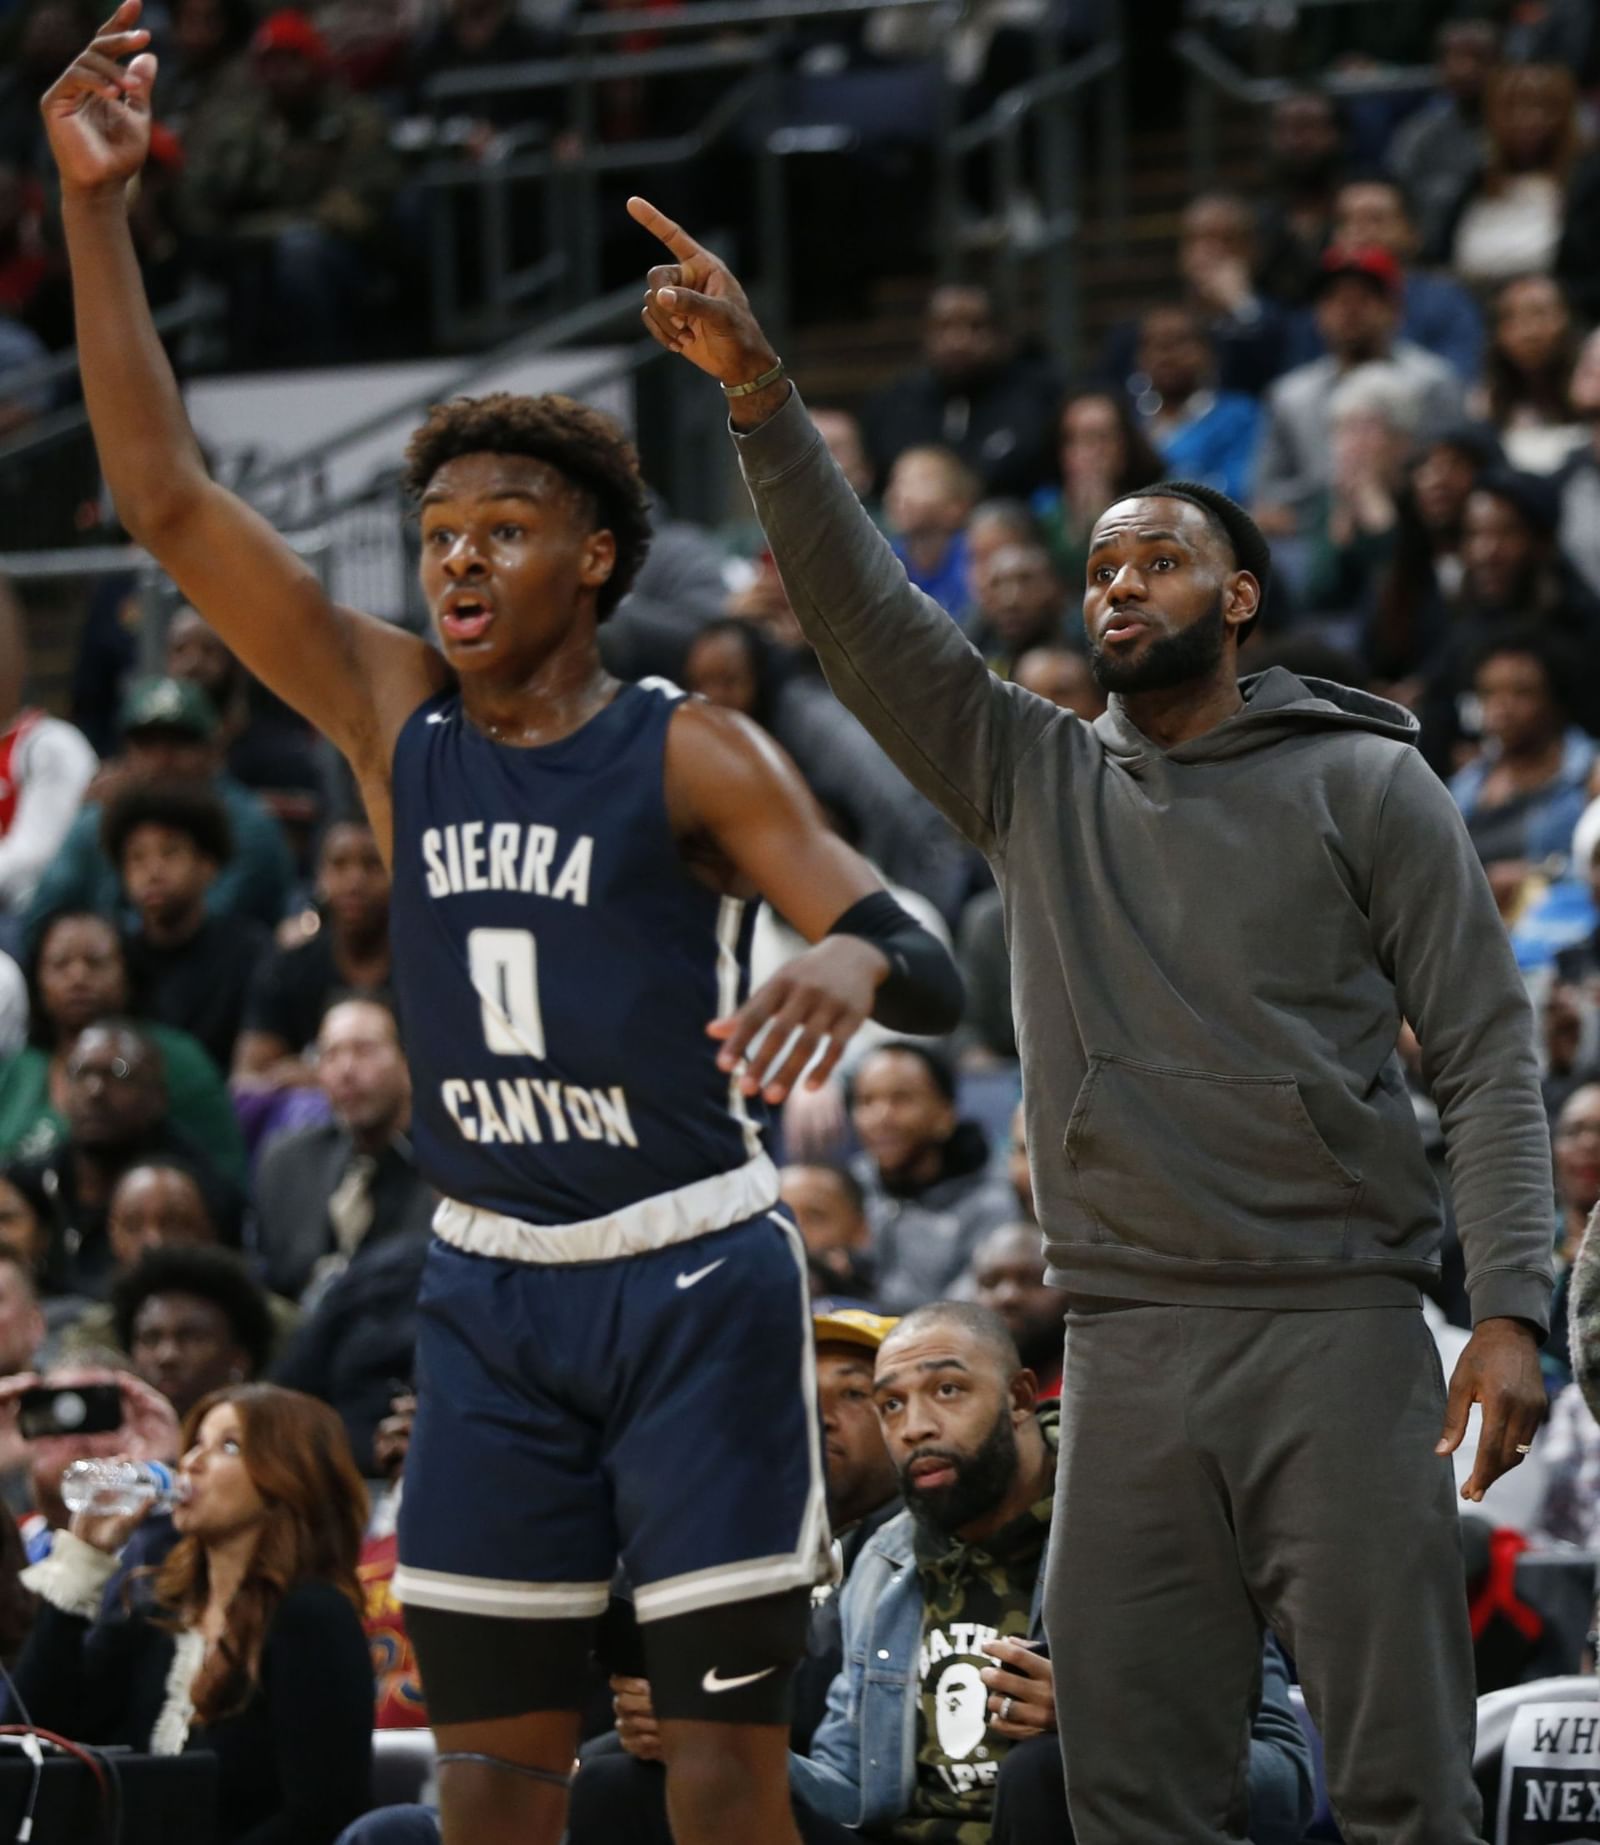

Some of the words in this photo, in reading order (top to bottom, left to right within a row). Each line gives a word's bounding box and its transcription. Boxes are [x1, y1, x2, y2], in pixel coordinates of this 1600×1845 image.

[422, 821, 594, 906] SIERRA
[467, 927, 546, 1061] 0
[441, 1078, 639, 1148] CANYON
[918, 1622, 1004, 1680] ATH
[1532, 1717, 1600, 1754] WH
